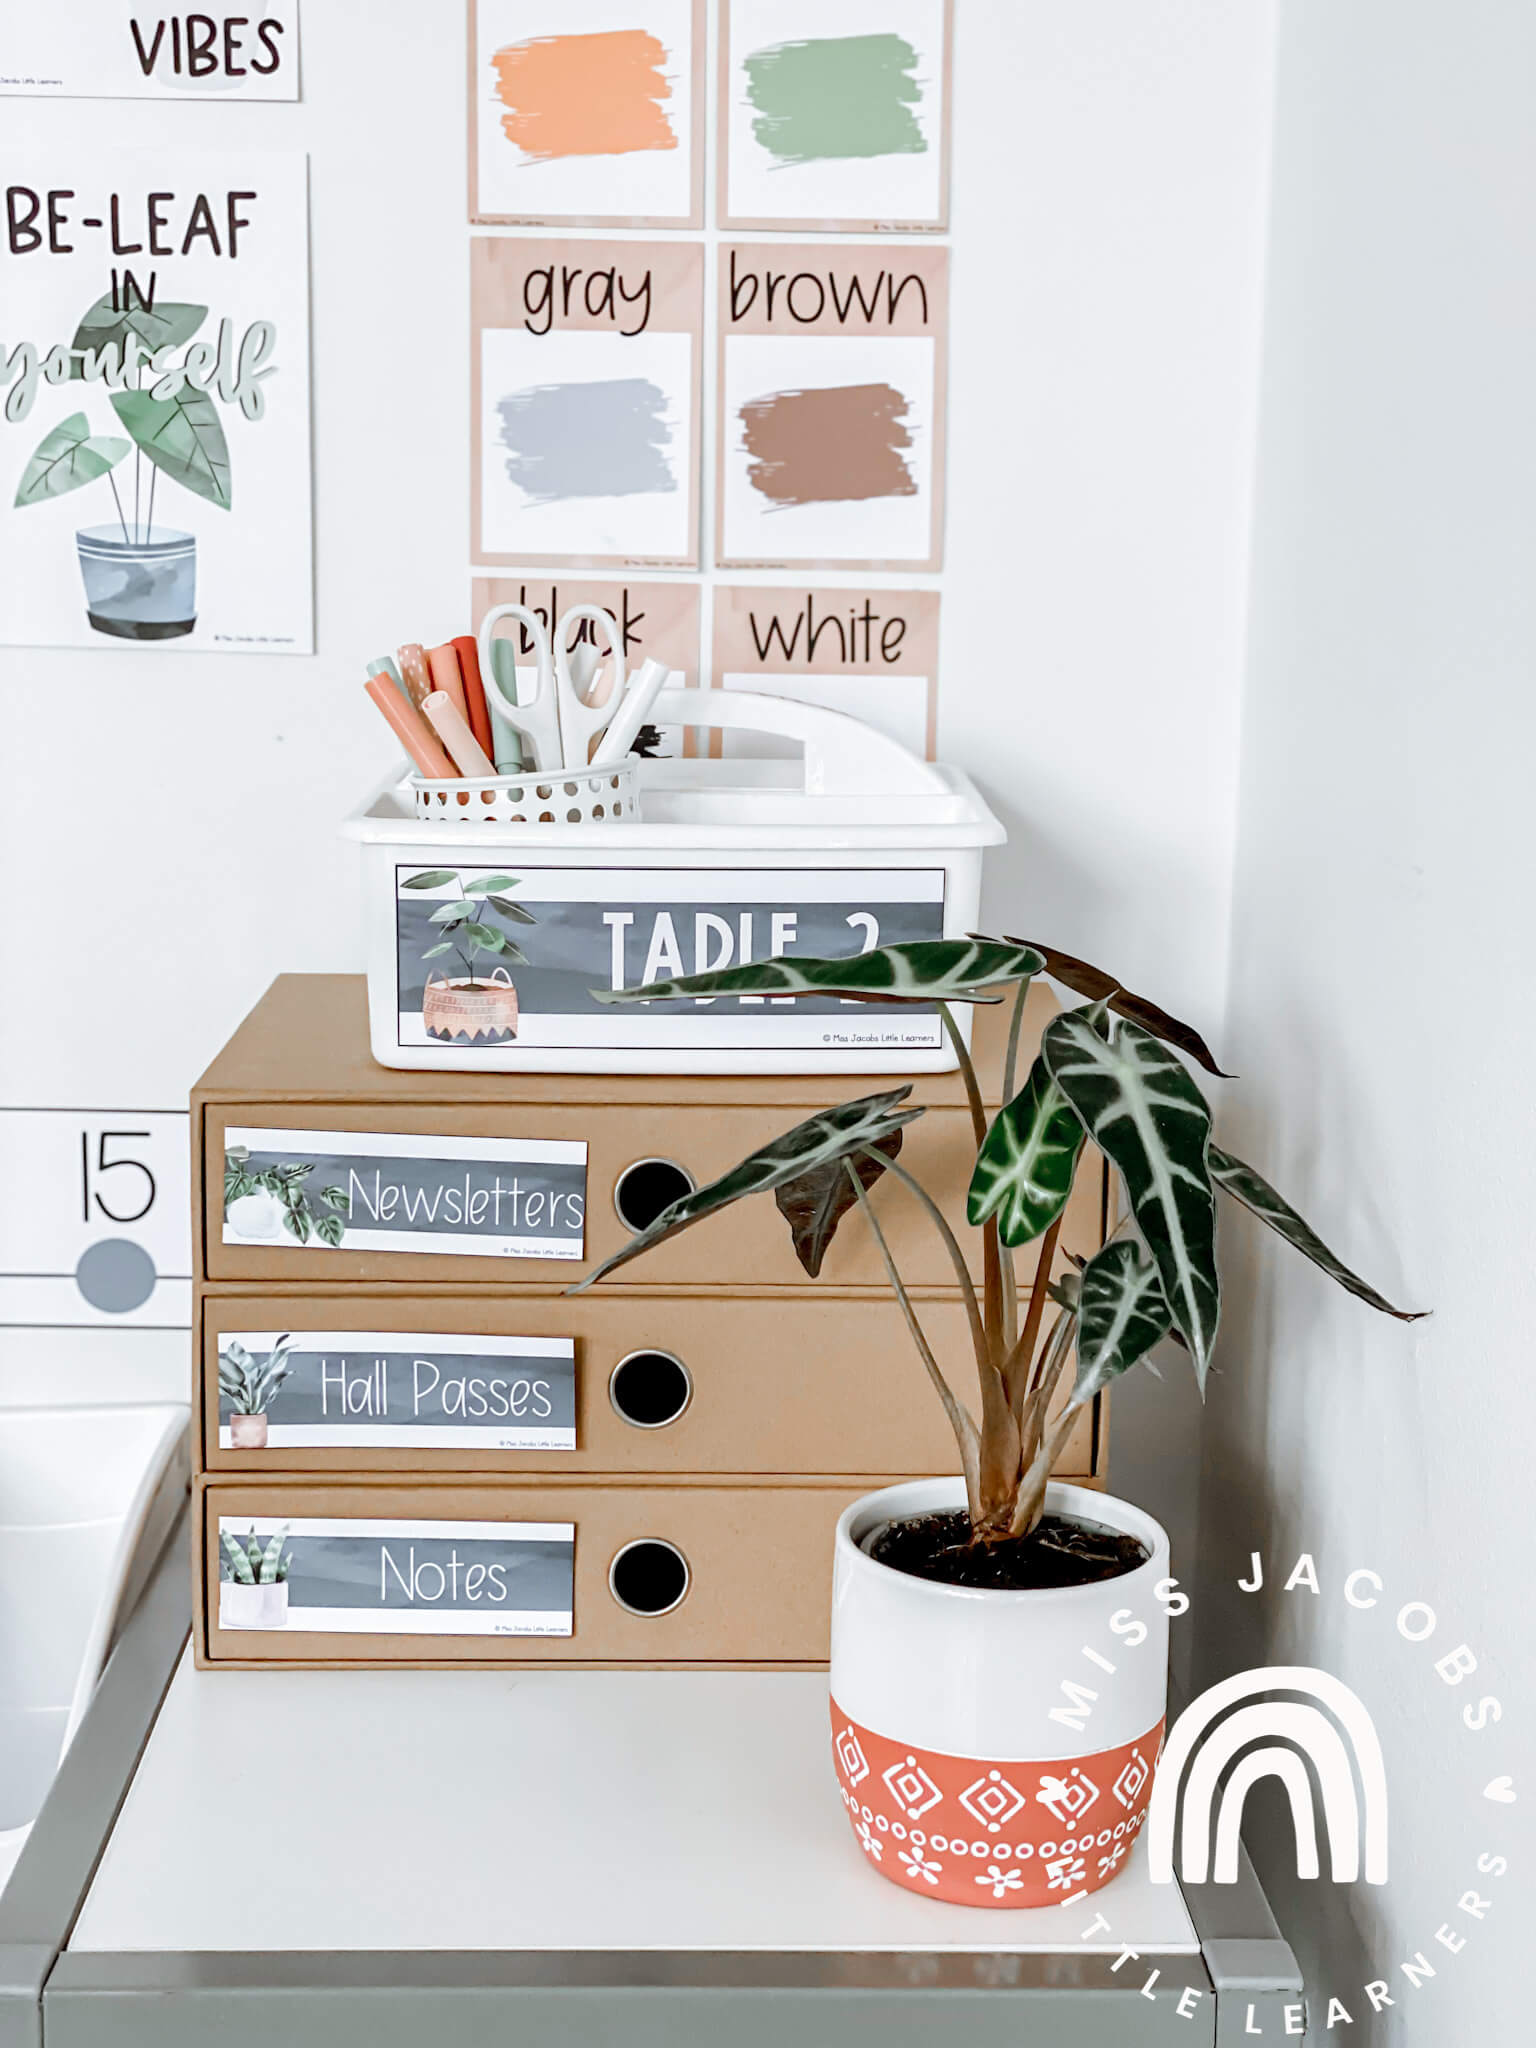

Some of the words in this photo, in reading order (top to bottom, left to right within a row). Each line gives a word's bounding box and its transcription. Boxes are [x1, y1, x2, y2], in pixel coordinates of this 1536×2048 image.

[130, 14, 284, 77] VIBES
[6, 186, 257, 259] BE-LEAF
[111, 267, 156, 314] IN
[523, 265, 651, 337] gray
[730, 250, 928, 325] brown
[0, 317, 279, 423] yourself
[749, 593, 907, 664] white
[82, 1131, 156, 1223] 15
[348, 1167, 584, 1229] Newsletters
[322, 1359, 388, 1417] Hall
[413, 1359, 552, 1418] Passes
[381, 1546, 508, 1601] Notes
